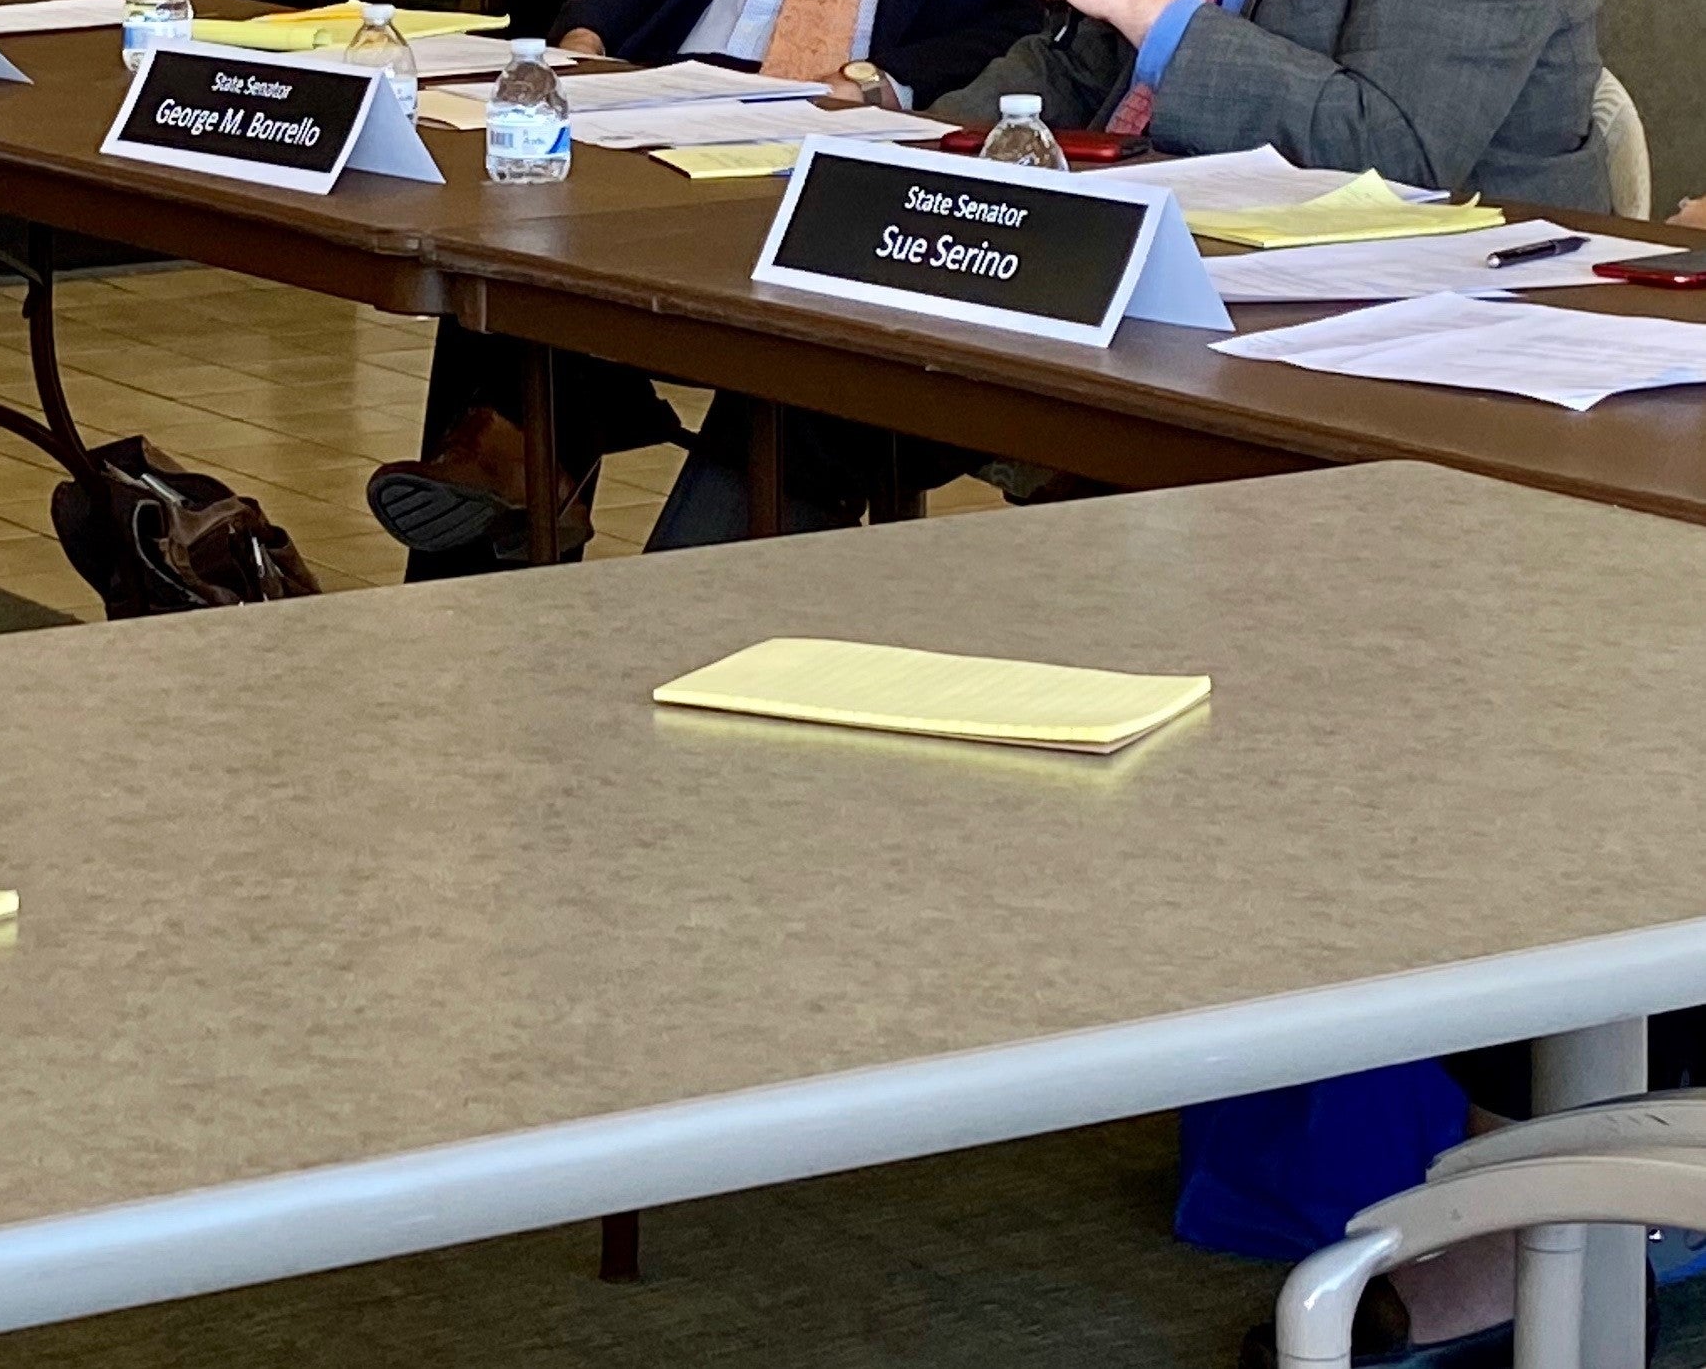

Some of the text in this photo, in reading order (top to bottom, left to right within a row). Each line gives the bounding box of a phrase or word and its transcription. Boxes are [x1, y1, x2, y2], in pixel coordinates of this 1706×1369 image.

[211, 72, 293, 100] State Senator
[155, 98, 321, 147] George M. Borrello
[904, 186, 1029, 228] State Senator
[875, 225, 1020, 280] Sue Serino
